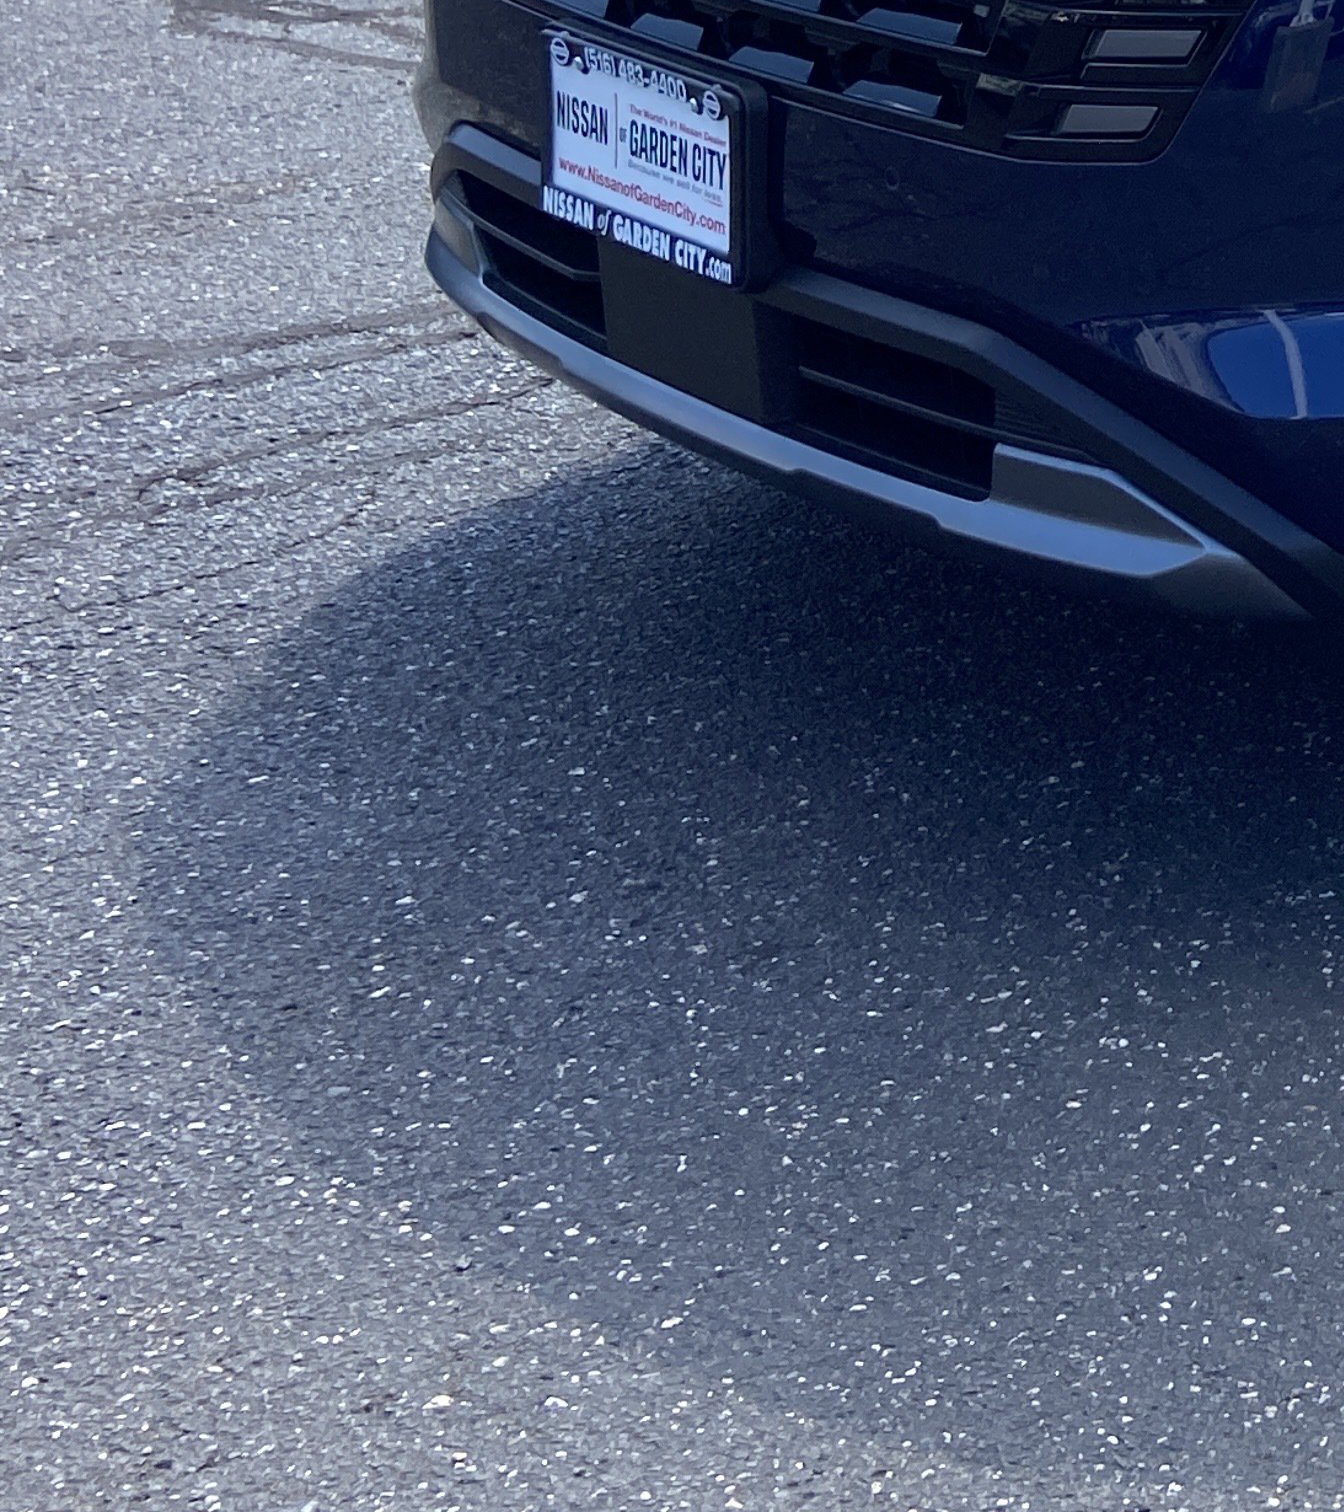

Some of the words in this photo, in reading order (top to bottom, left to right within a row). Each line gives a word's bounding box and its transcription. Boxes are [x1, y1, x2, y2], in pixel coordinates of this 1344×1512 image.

[584, 47, 616, 77] (516)
[619, 59, 688, 102] 483-4400
[557, 90, 608, 145] NISSAN
[629, 119, 688, 178] GARDEN
[692, 143, 727, 191] CITY
[543, 185, 595, 231] NISSAN
[596, 211, 612, 237] of
[612, 214, 671, 262] GARDEN
[674, 238, 733, 285] CITY.com
[558, 157, 726, 236] www.NissanofGardenCity.com
